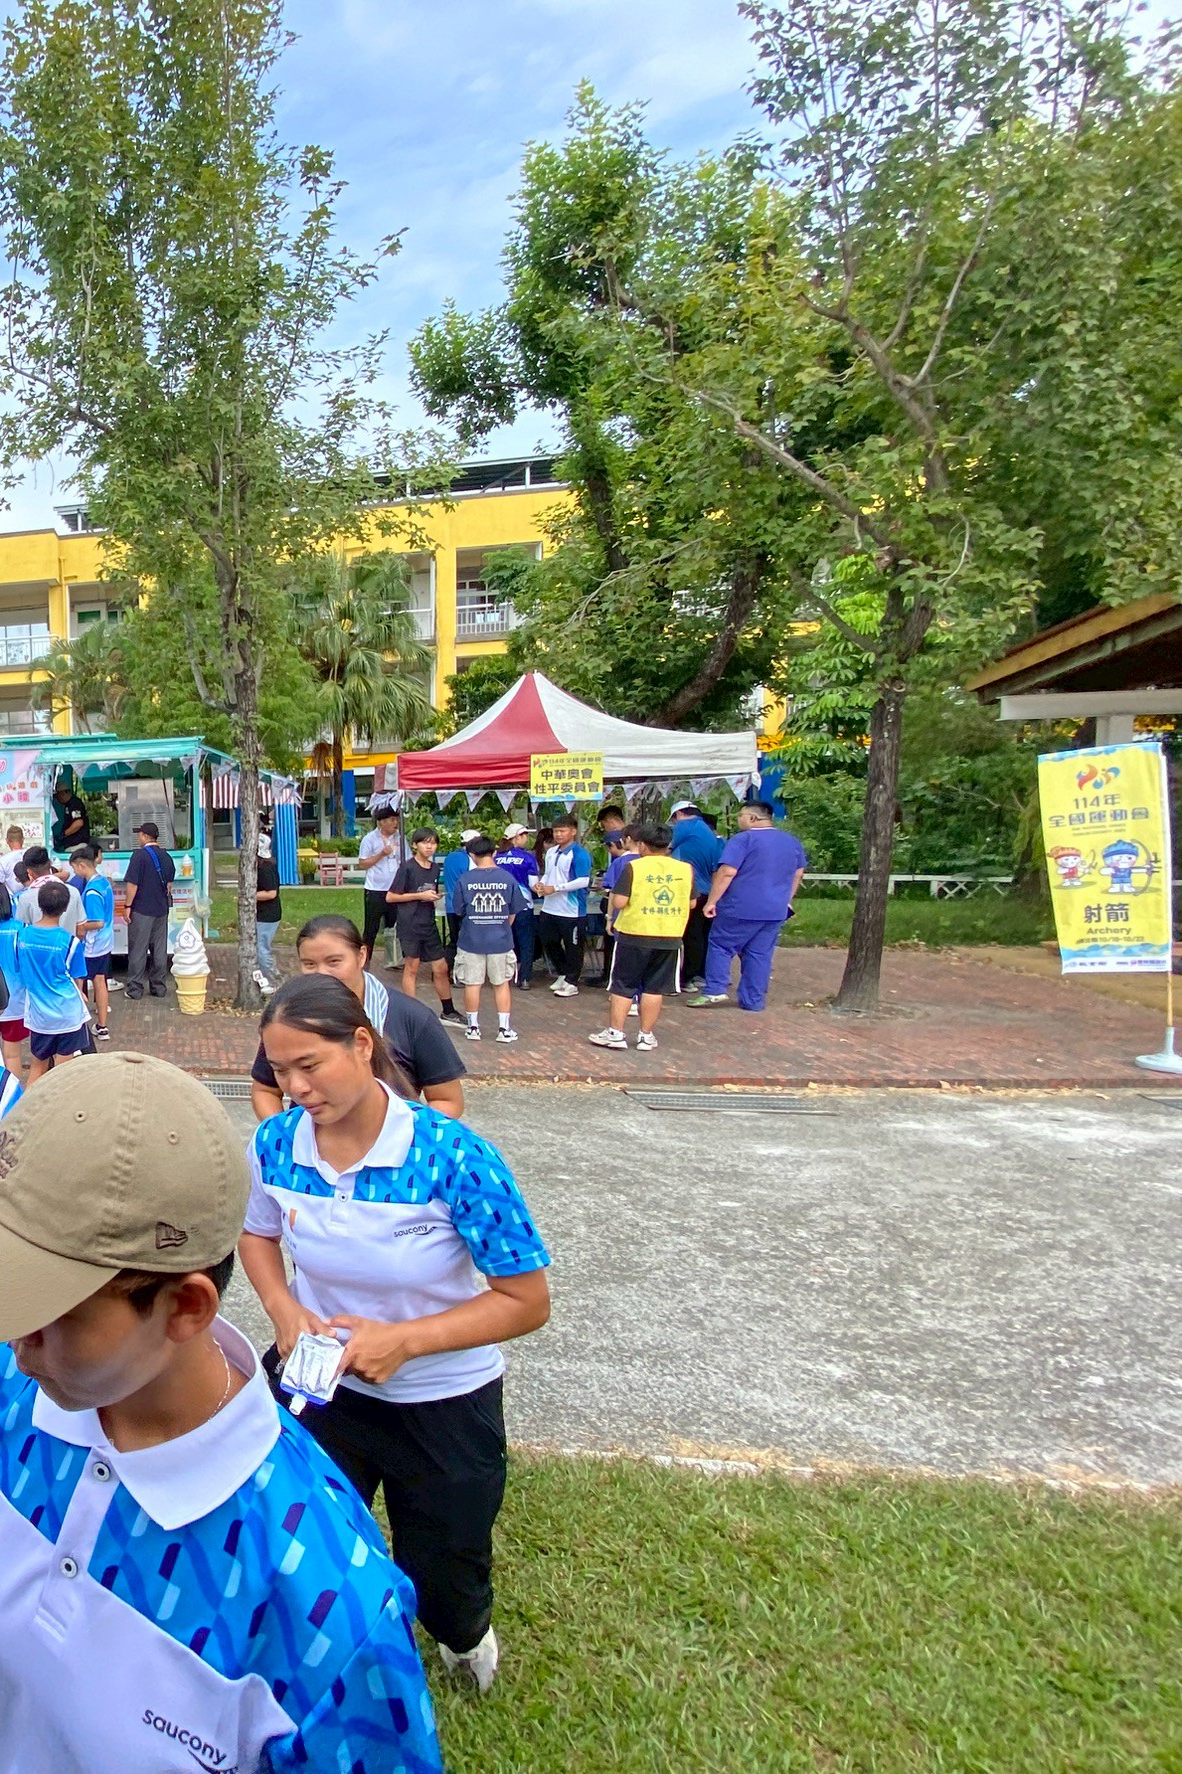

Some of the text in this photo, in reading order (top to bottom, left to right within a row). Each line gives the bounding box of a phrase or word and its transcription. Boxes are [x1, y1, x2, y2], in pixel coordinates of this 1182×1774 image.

[541, 768, 593, 780] 中華奧會
[534, 781, 600, 794] 性平委員會
[1074, 794, 1121, 810] 114年
[1048, 807, 1149, 828] 全國運動會
[645, 874, 683, 884] 安全第一
[1084, 902, 1130, 923] 射箭
[1086, 927, 1131, 935] Archery
[393, 1223, 428, 1238] saucony
[141, 1709, 227, 1766] saucony
